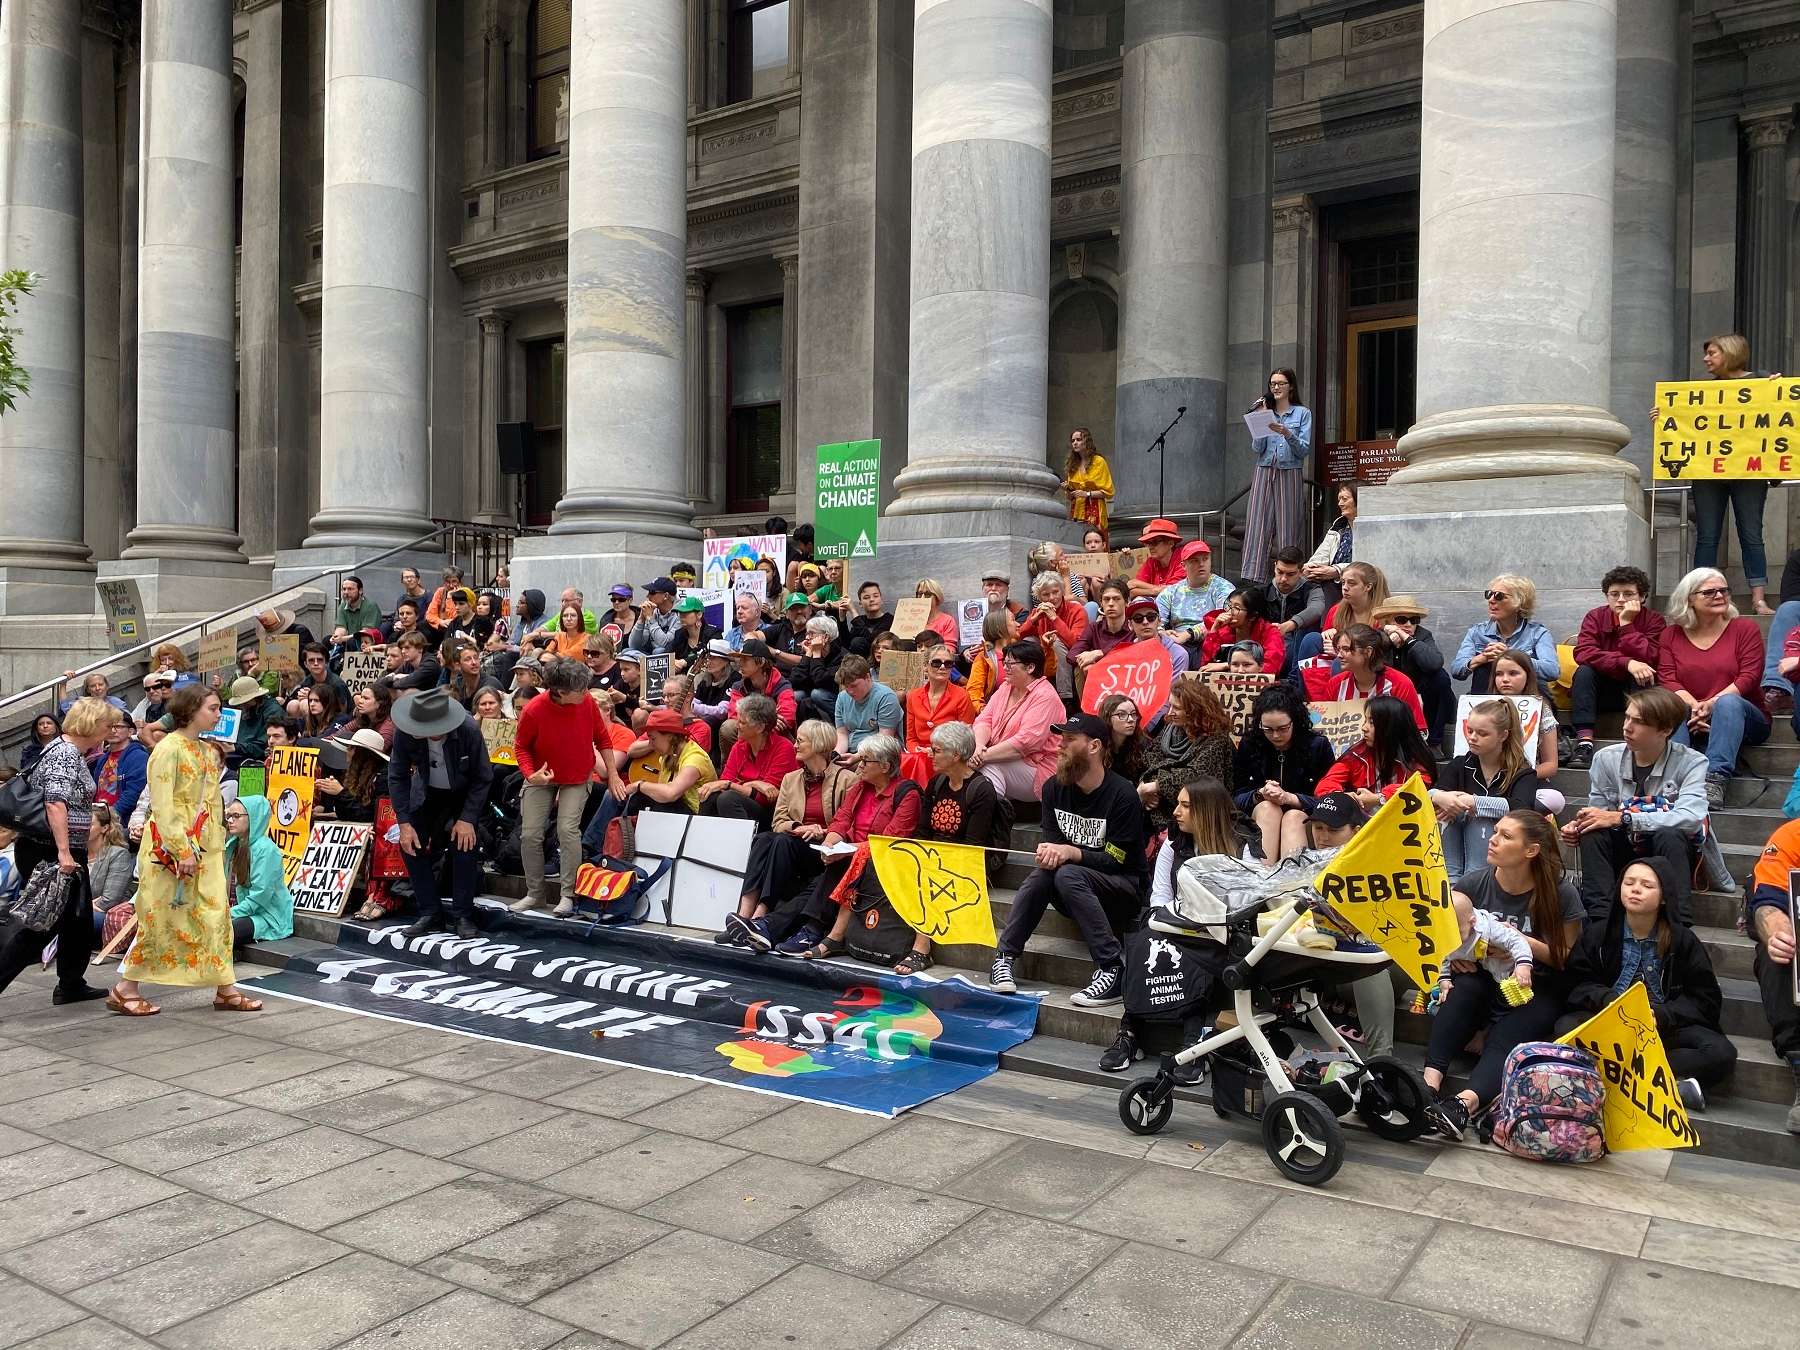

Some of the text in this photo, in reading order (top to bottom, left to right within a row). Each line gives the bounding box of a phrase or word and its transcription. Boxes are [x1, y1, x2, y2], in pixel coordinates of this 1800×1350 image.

[1664, 384, 1800, 407] THIS IS
[1662, 411, 1794, 431] A CLIMA
[1360, 448, 1398, 457] PARLIAM
[1659, 437, 1789, 456] THIS IS
[819, 458, 877, 474] REAL ACTION
[1359, 455, 1406, 464] HOUSE TOU
[1713, 455, 1793, 473] EME
[819, 472, 876, 489] ON CLIMATE
[818, 488, 876, 509] CHANGE
[748, 536, 785, 553] WANT
[817, 545, 838, 555] VOTE
[704, 572, 728, 589] FU
[347, 656, 386, 669] PLANE
[356, 670, 379, 679] OVER
[1100, 659, 1160, 691] STOP
[346, 679, 374, 692] PRO
[1221, 694, 1259, 712] UST
[1320, 711, 1363, 726] who
[270, 750, 318, 778] PLANET
[1057, 811, 1084, 827] EATING
[268, 828, 299, 853] NOT
[320, 825, 352, 845] YOU
[302, 845, 361, 869] CAN NOT
[309, 869, 339, 890] EAT
[1398, 791, 1440, 985] ANIMAL
[290, 889, 343, 911] MONEY!
[532, 956, 732, 1006] STRIKE
[1145, 971, 1184, 986] FIGHTING
[1150, 982, 1183, 996] ANIMAL
[370, 969, 688, 1038] CLIMATE
[1149, 992, 1185, 1006] TESTING
[1602, 1058, 1698, 1147] BELLION
